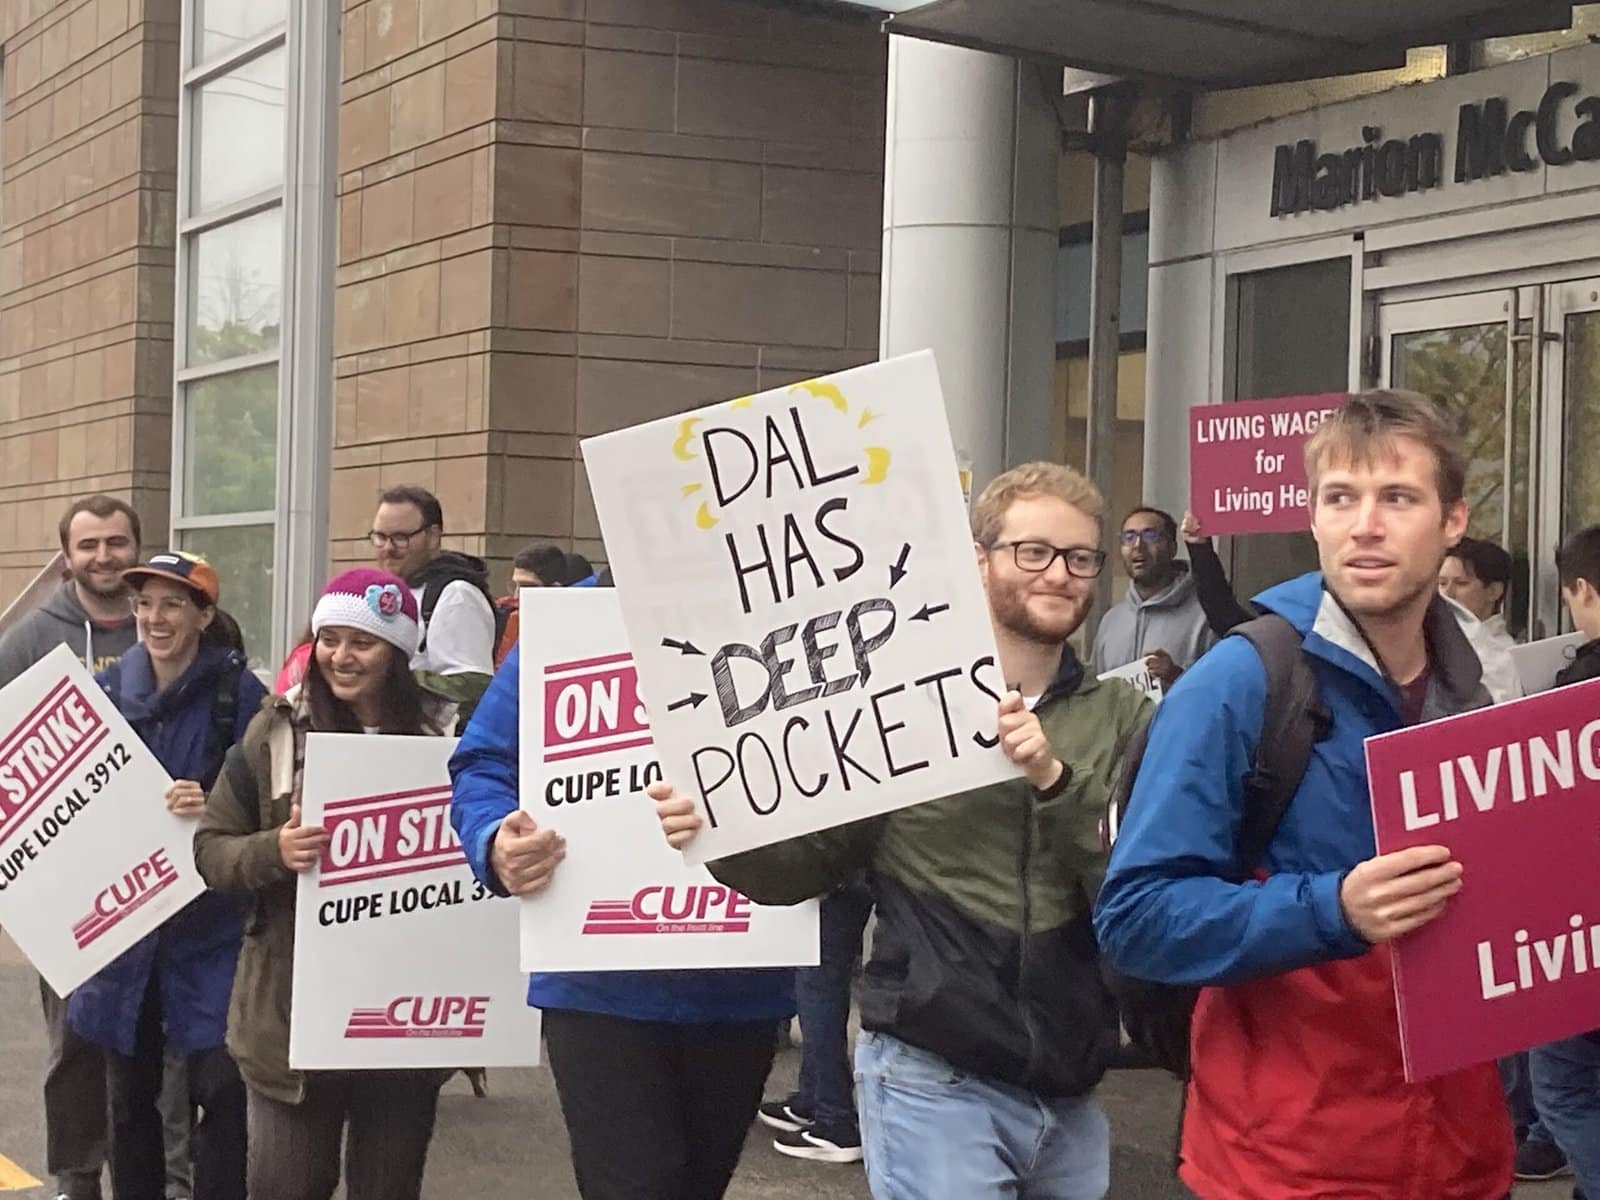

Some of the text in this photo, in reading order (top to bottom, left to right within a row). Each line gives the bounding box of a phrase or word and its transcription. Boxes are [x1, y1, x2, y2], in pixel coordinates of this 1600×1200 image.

[1270, 126, 1443, 217] Marion
[702, 407, 859, 507] DAL
[1197, 415, 1265, 443] LIVING
[1255, 449, 1285, 474] for
[1214, 484, 1311, 516] Living He
[725, 497, 865, 614] HAS
[710, 598, 897, 728] DEEP
[554, 676, 621, 739] ON
[0, 692, 96, 806] STRIKE
[691, 655, 1003, 829] POCKETS
[33, 788, 91, 848] LOCAL
[85, 743, 132, 794] 3912
[545, 767, 621, 807] CUPE
[330, 814, 388, 868] ON
[94, 847, 175, 917] CUPE
[319, 893, 383, 927] CUPE
[390, 880, 465, 914] LOCAL
[631, 886, 752, 920] CUPE
[386, 996, 491, 1026] CUPE
